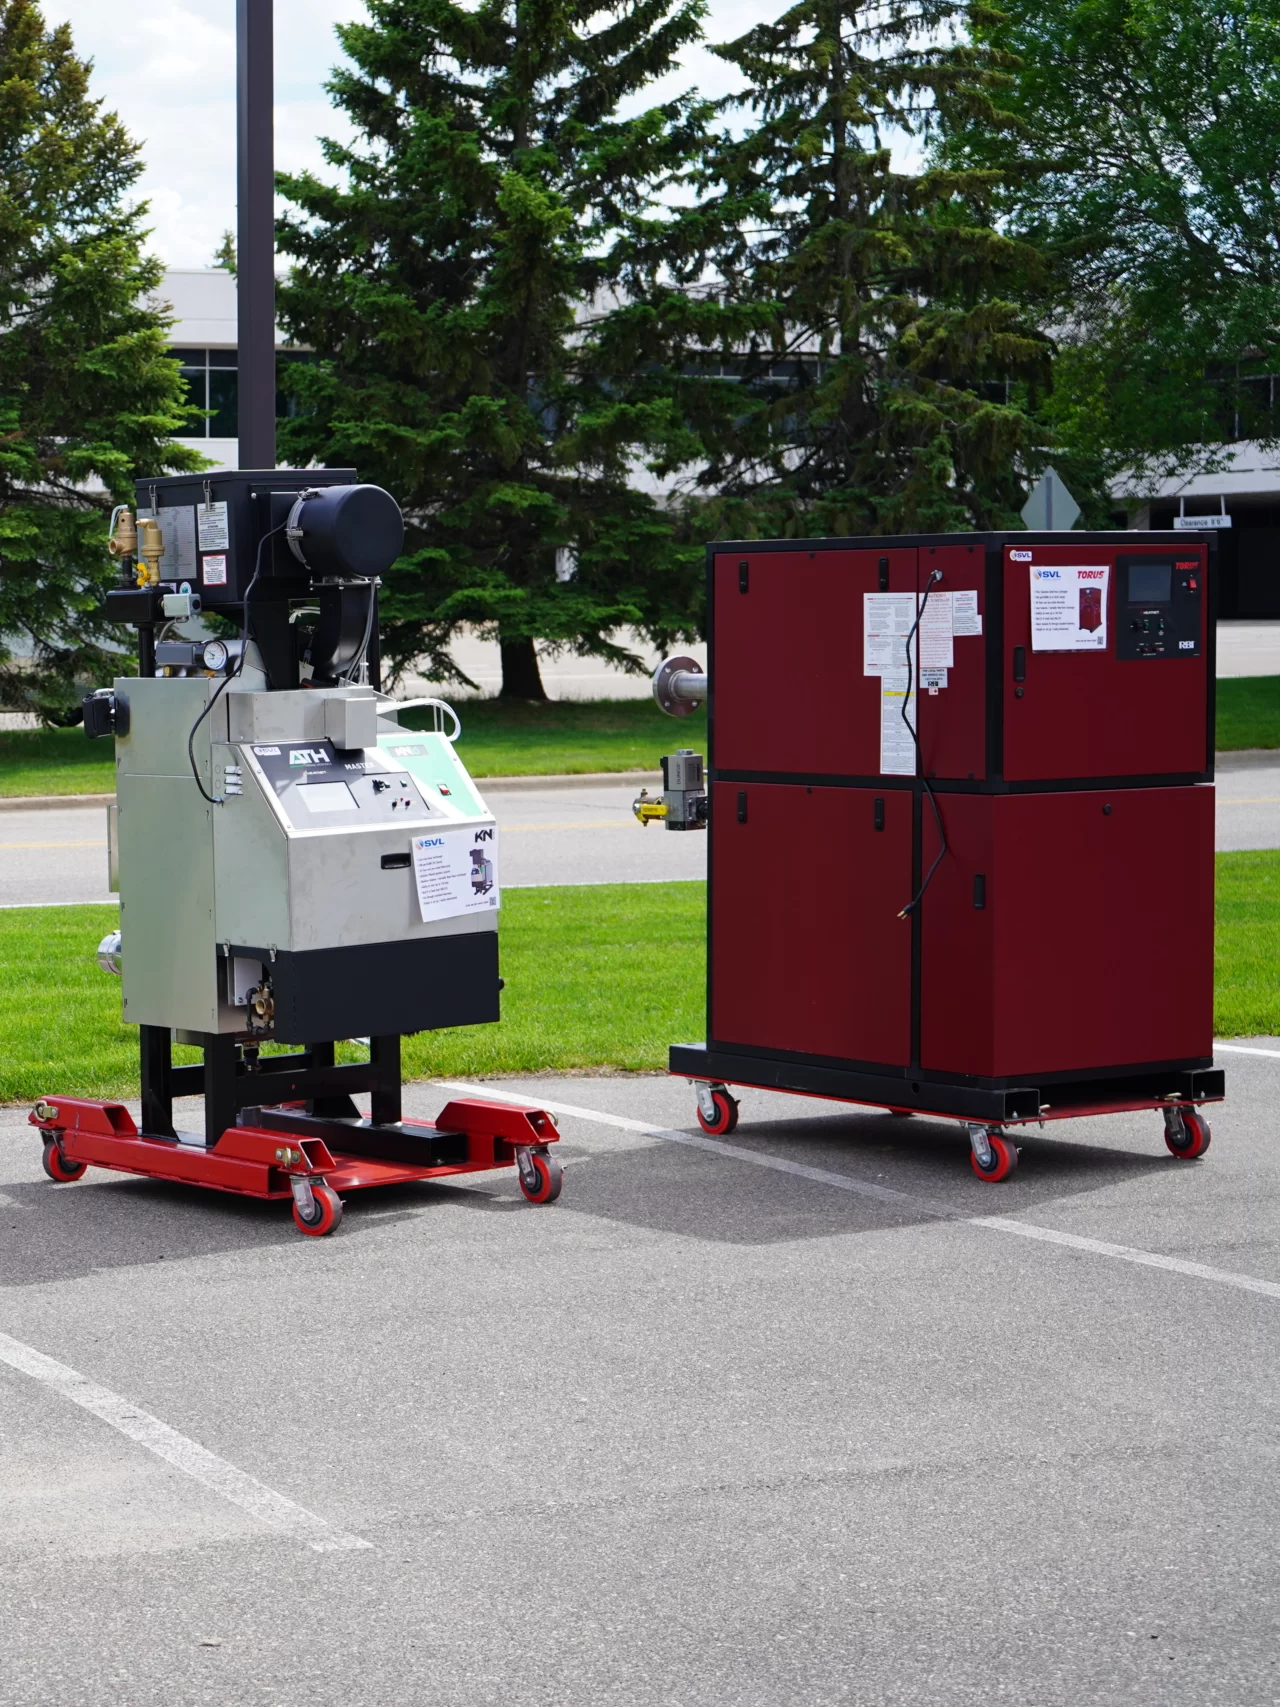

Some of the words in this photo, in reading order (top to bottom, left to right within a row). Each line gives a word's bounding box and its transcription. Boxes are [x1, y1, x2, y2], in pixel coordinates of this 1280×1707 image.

[1175, 561, 1199, 570] TORUS
[1042, 570, 1062, 578] SVL
[1077, 570, 1105, 579] TORUS
[1179, 641, 1194, 649] RBI
[289, 749, 330, 765] ATH
[344, 762, 376, 771] MASTER
[474, 829, 493, 843] KN
[424, 838, 445, 848] SVL
